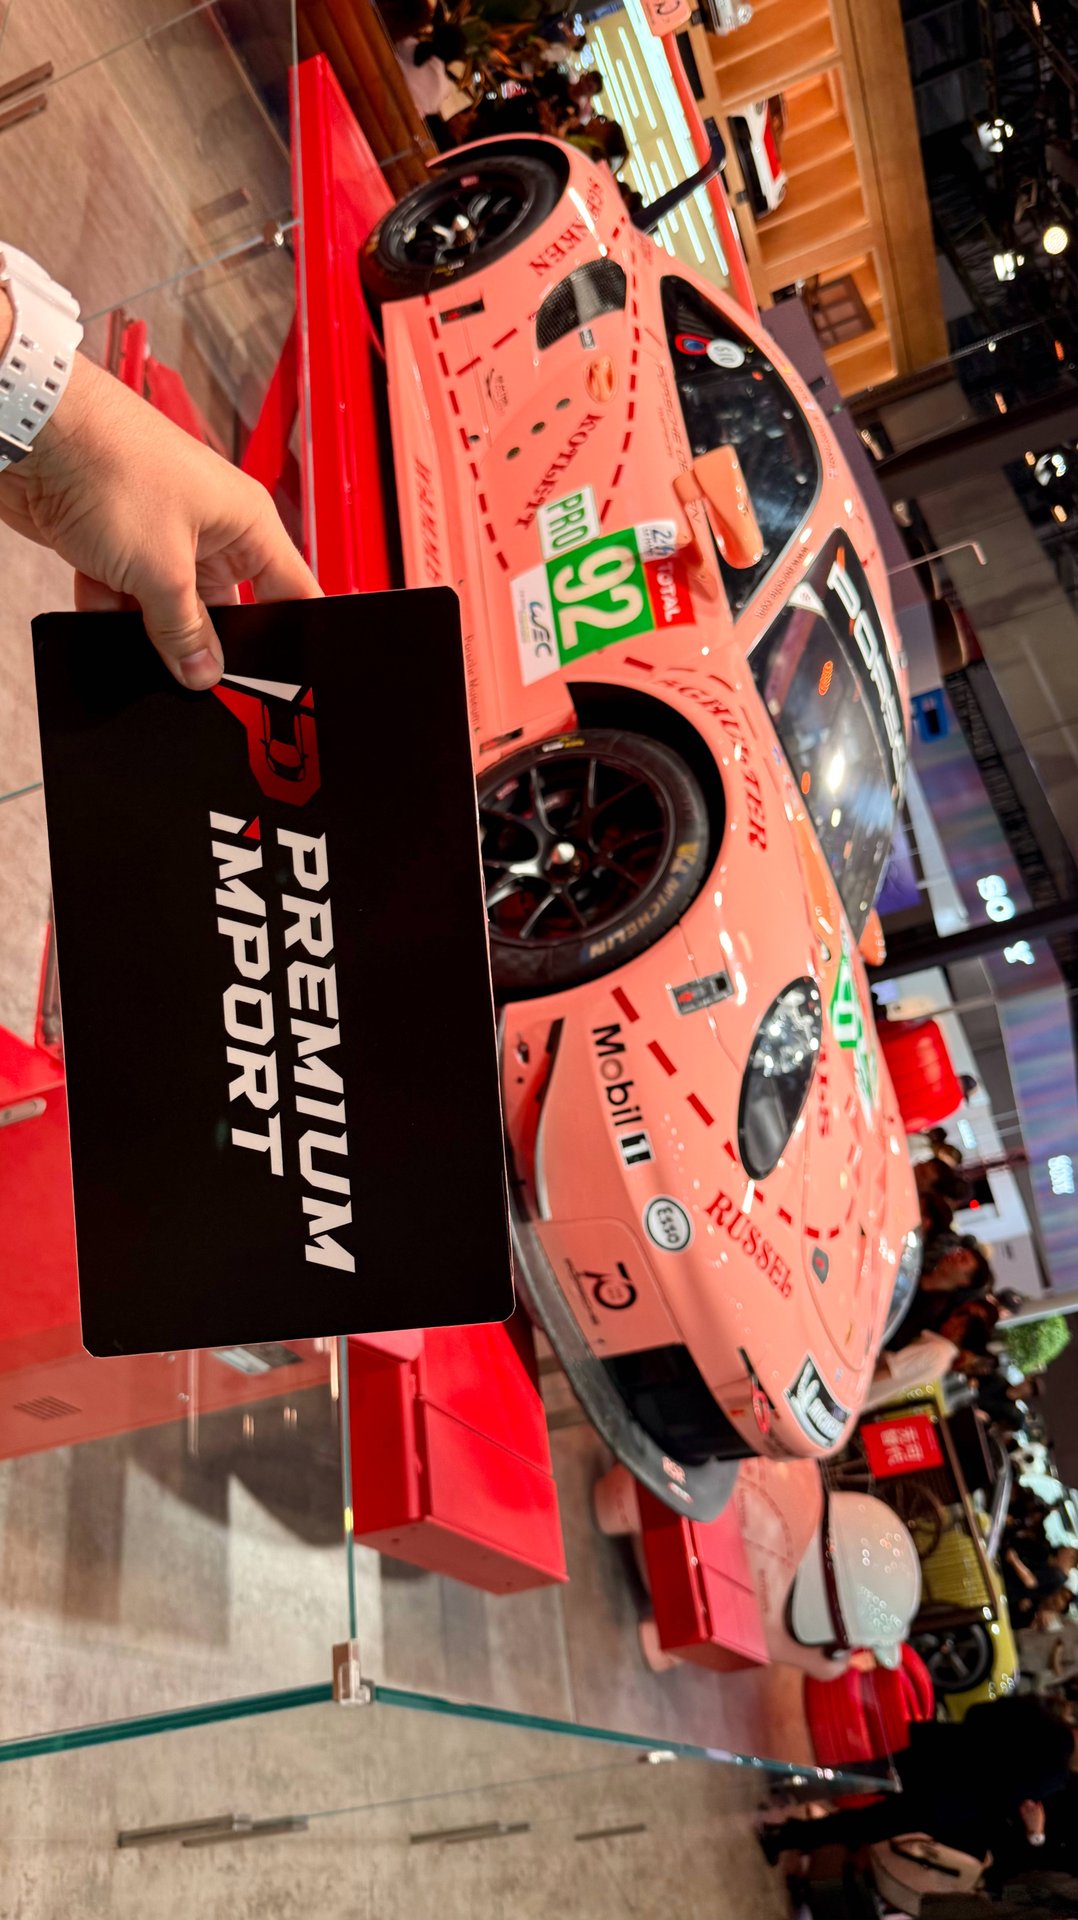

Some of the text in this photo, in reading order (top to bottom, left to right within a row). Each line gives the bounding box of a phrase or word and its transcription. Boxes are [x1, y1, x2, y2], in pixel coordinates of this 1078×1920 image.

[546, 493, 589, 550] PRO
[552, 545, 644, 650] 92
[656, 561, 681, 623] TOTAL
[588, 879, 680, 960] MICHELIN
[976, 875, 1035, 965] SOY
[277, 828, 356, 1273] PREMIUM
[591, 1023, 643, 1127] Mobil
